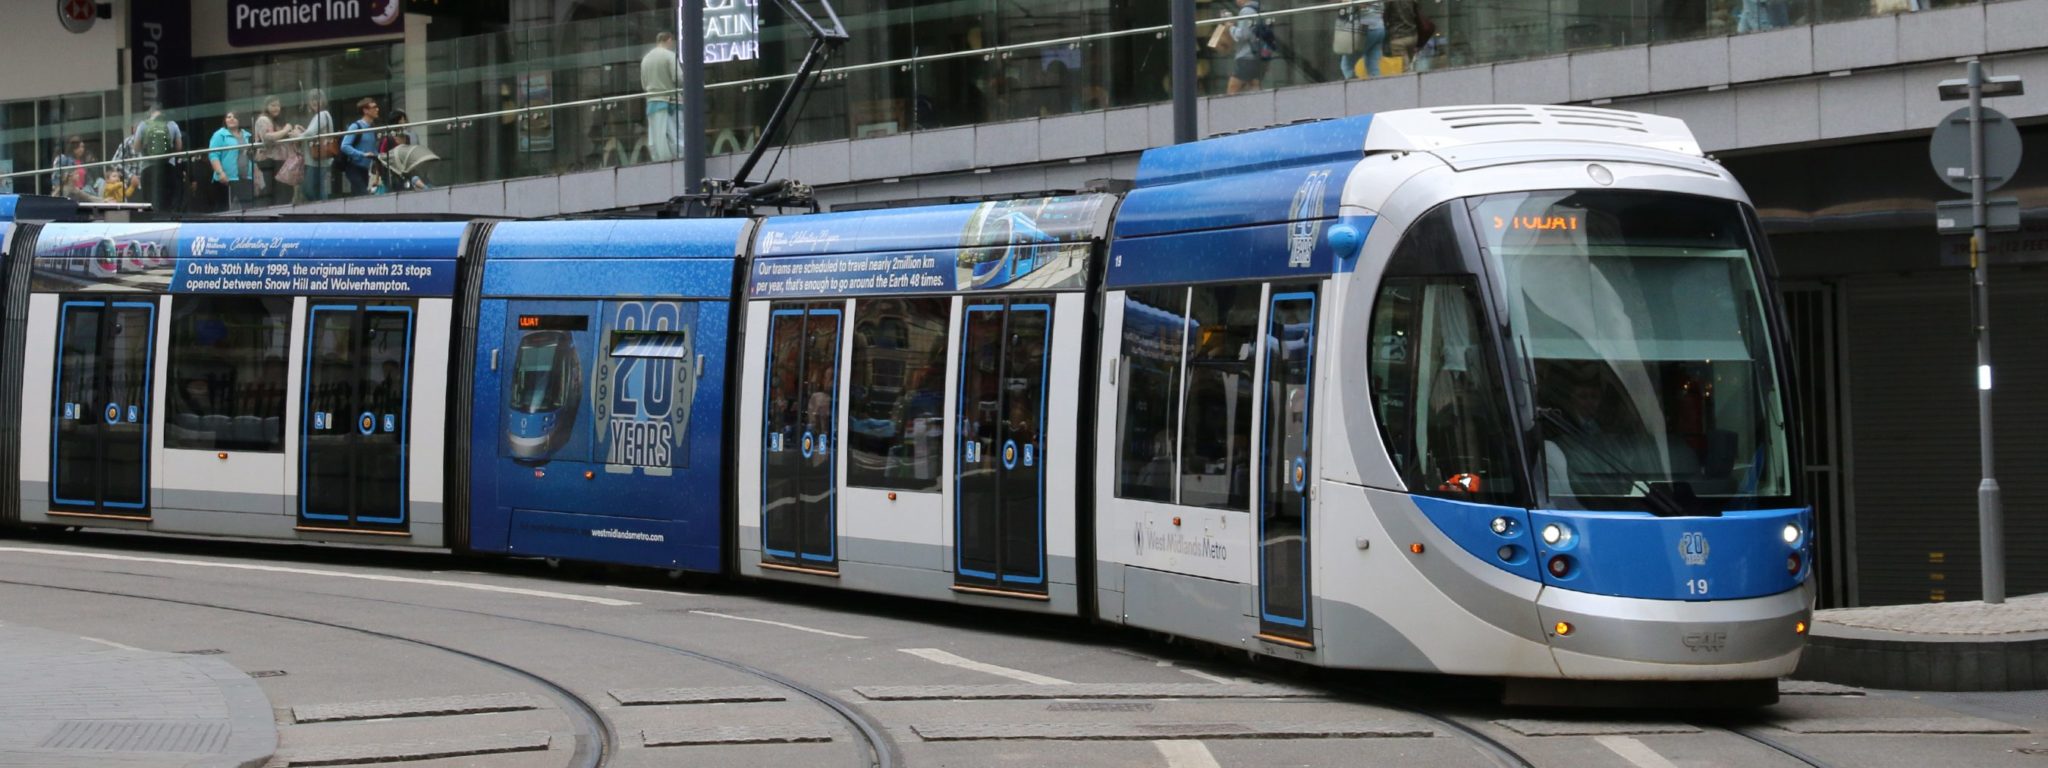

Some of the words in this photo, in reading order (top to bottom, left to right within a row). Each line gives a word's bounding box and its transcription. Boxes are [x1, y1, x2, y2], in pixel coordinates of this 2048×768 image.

[236, 0, 321, 29] Premier
[326, 0, 359, 20] Inn
[703, 14, 758, 38] ATIN
[703, 40, 759, 63] STAIR
[188, 262, 202, 275] On
[204, 263, 219, 275] the
[221, 263, 242, 275] 30th
[244, 264, 264, 277] May
[267, 264, 291, 277] 1999,
[292, 264, 308, 275] the
[310, 263, 346, 278] original
[348, 263, 365, 276] line
[367, 263, 389, 276] with
[391, 264, 403, 276] 23
[405, 265, 432, 278] stops
[759, 262, 771, 275] Our
[772, 263, 791, 275] trams
[792, 264, 802, 274] are
[804, 258, 838, 274] scheduled
[840, 260, 847, 272] to
[848, 256, 868, 272] travel
[868, 255, 892, 274] nearly
[892, 254, 921, 270] 2million
[922, 254, 935, 268] km
[186, 277, 221, 292] opened
[222, 277, 262, 290] between
[264, 278, 290, 290] Snow
[292, 278, 309, 290] Hill
[310, 278, 328, 290] and
[331, 278, 410, 293] Wolverhampton.
[756, 282, 768, 295] per
[768, 281, 784, 294] year,
[785, 277, 803, 291] that's
[804, 276, 829, 293] enough
[830, 277, 838, 289] to
[839, 280, 849, 292] go
[849, 274, 874, 288] around
[876, 274, 888, 288] the
[888, 273, 909, 288] Earth
[910, 273, 920, 287] 48
[921, 272, 944, 286] times.
[612, 301, 680, 418] 20
[598, 344, 609, 421] 1999
[611, 419, 672, 467] YEARS
[591, 528, 664, 542] westmidlandsmetro.com
[1147, 530, 1166, 552] West
[1168, 533, 1202, 556] Midlands
[1202, 537, 1227, 560] Metro
[1684, 533, 1703, 554] 20
[1686, 579, 1708, 595] 19
